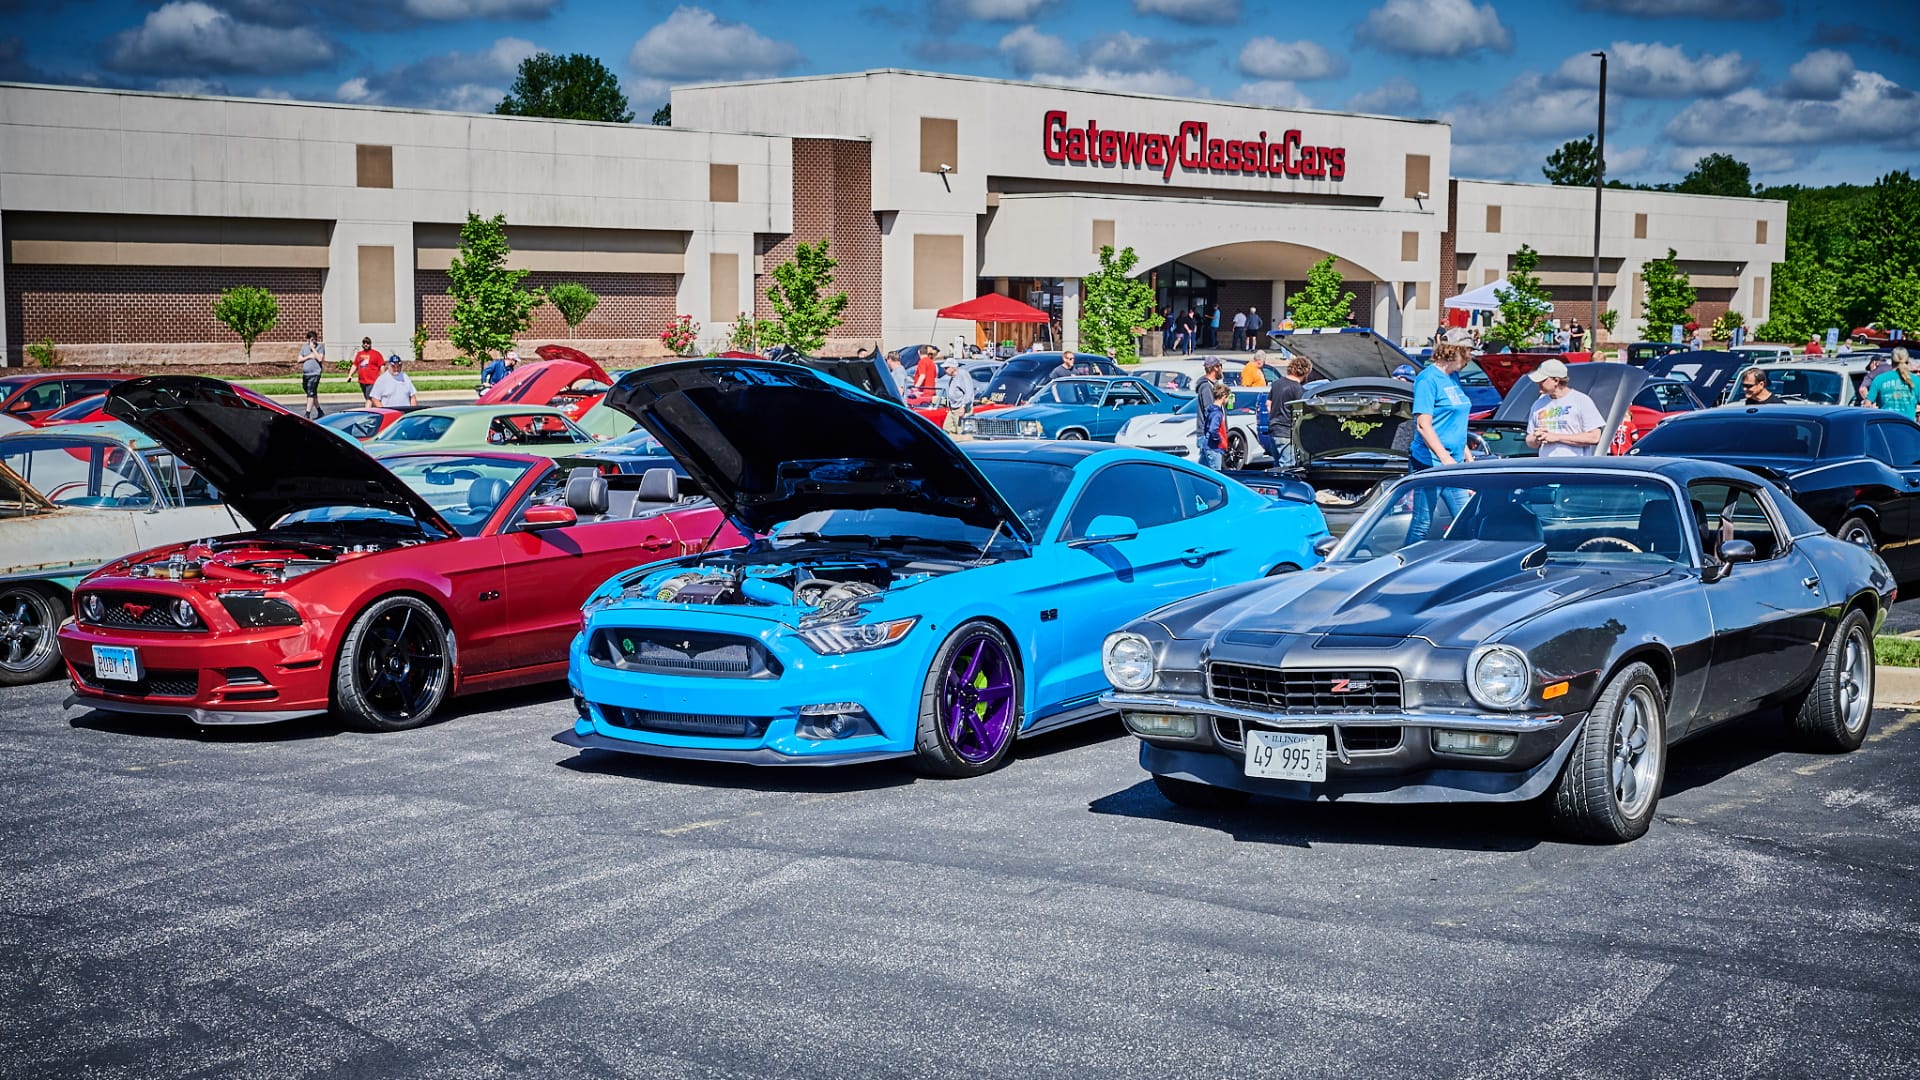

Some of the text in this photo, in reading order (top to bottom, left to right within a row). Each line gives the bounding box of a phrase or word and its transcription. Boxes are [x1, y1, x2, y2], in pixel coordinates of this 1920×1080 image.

[98, 656, 117, 672] RUBY
[1271, 735, 1307, 744] ILLINOIS
[1254, 745, 1311, 770] 49 995
